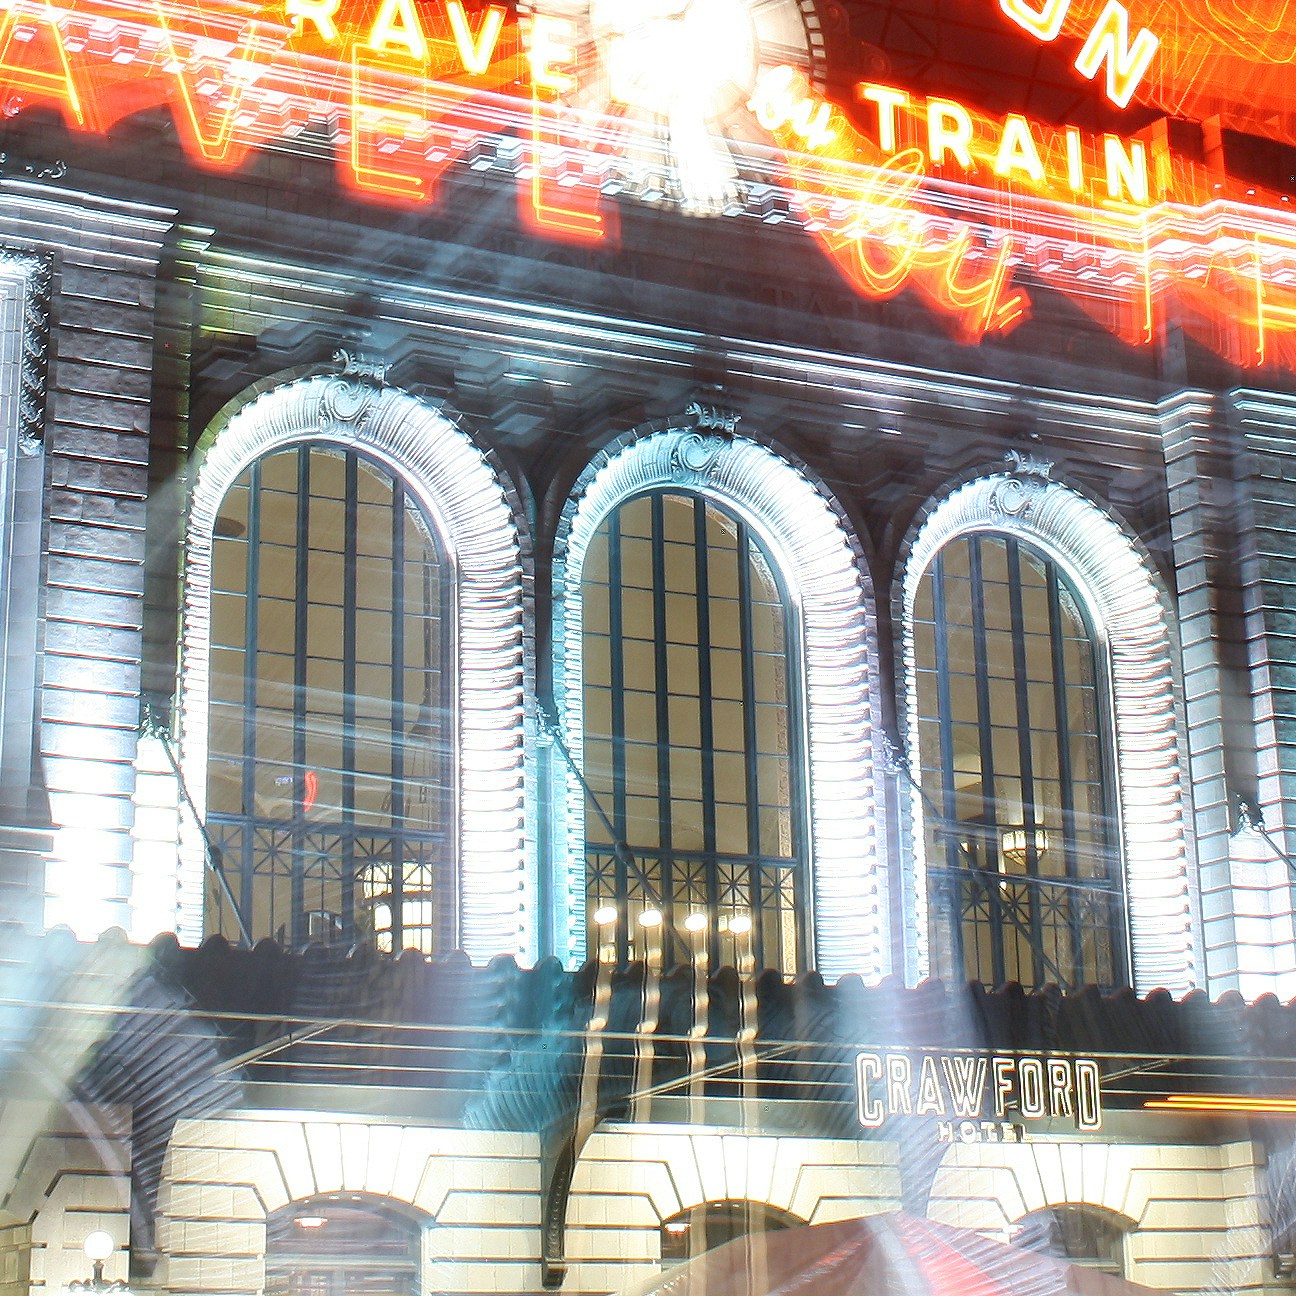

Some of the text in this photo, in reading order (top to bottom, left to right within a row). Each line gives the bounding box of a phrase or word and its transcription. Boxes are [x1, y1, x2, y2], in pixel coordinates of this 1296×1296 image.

[857, 82, 1150, 203] TRAIN
[855, 1051, 1103, 1131] CRAWFORD
[937, 1120, 1033, 1144] HOTEL
